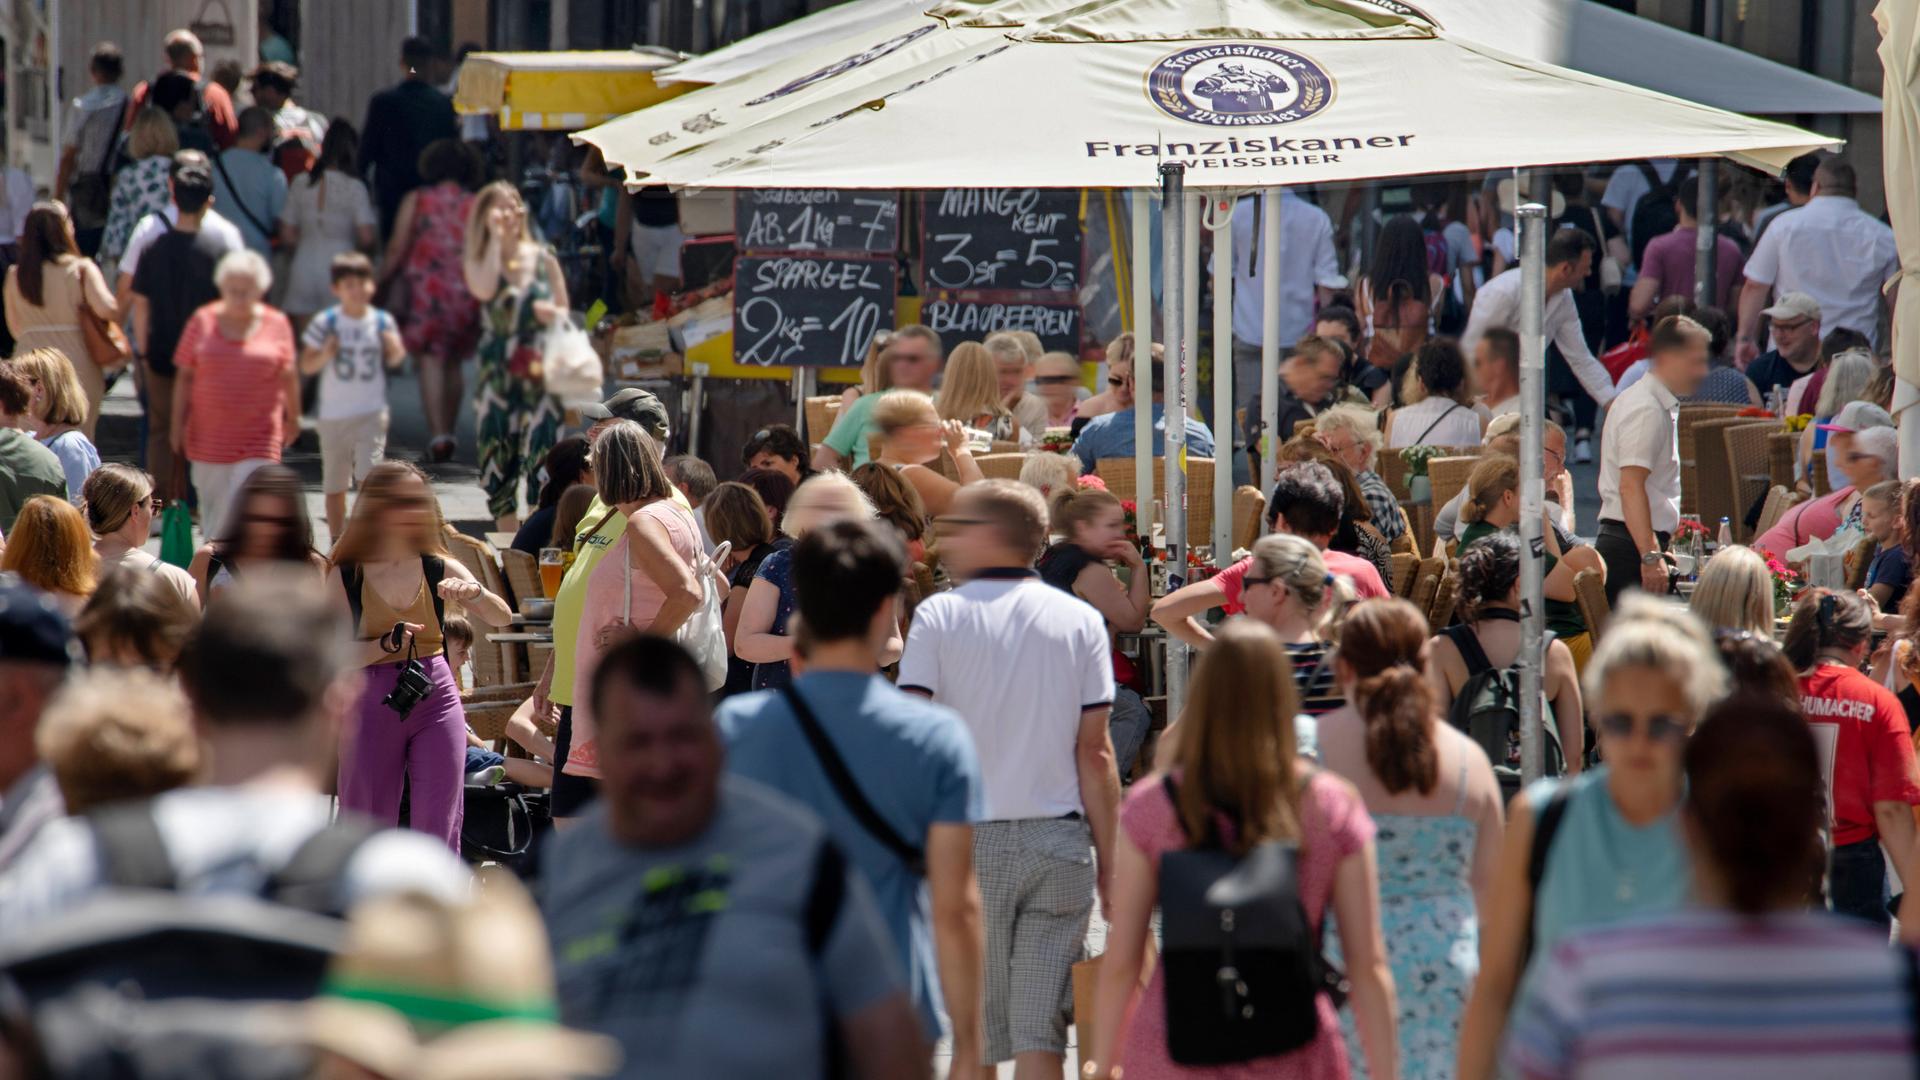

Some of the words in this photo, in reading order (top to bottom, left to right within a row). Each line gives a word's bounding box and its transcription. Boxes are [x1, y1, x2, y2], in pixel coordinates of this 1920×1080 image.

[1163, 46, 1307, 71] Franziskaner
[1187, 109, 1303, 126] Weissbier
[1085, 134, 1416, 158] Franziskaner
[938, 187, 1041, 219] MANGO
[1011, 213, 1067, 235] KENT
[752, 257, 881, 293] SPARGEL
[828, 296, 880, 365] 10
[929, 301, 1074, 336] BLAUBEEREN
